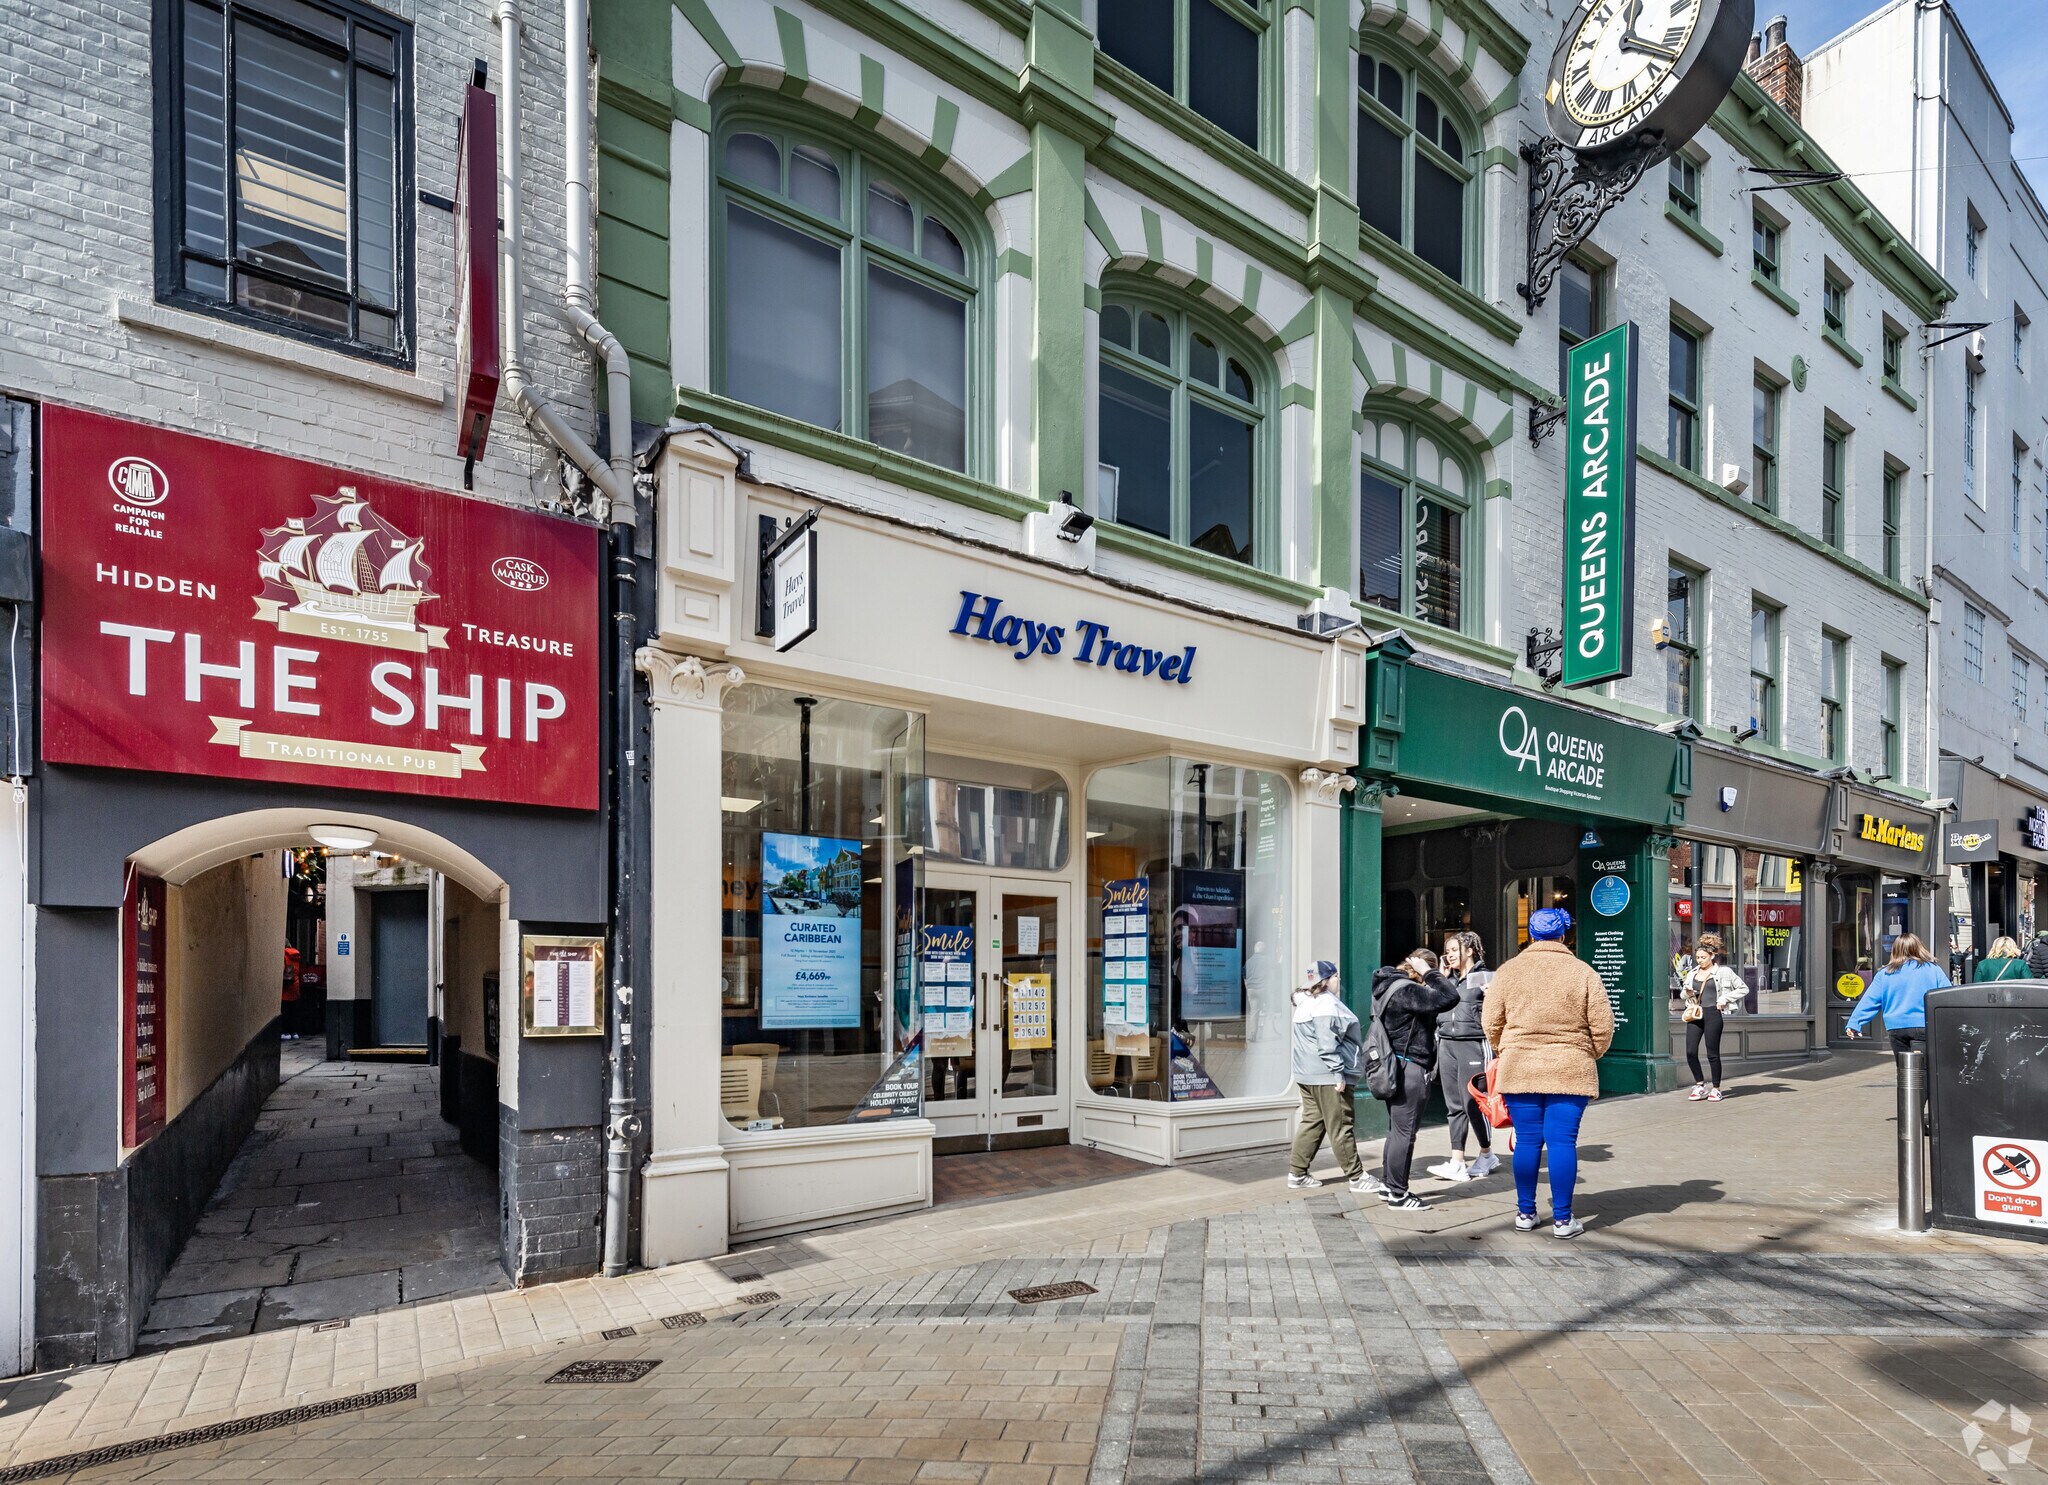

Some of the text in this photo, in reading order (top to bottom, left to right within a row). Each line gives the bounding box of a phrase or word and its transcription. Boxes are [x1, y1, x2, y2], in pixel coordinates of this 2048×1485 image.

[1586, 87, 1668, 146] ARCADE
[117, 466, 155, 499] CAMRA
[113, 503, 165, 521] CAMPAIGN
[1579, 353, 1611, 659] QUEENS ARCADE
[115, 523, 163, 539] REAL ALE
[129, 516, 149, 527] FOR
[497, 567, 545, 585] MARQUE
[505, 560, 535, 573] CASK
[96, 562, 216, 600] HIDDEN
[784, 571, 804, 597] Hays
[782, 586, 806, 620] Travel
[320, 622, 389, 642] EST. 1755
[462, 622, 574, 657] TREASURE
[949, 590, 1197, 685] Hays Travel
[100, 621, 566, 743] THE SHIP
[1499, 706, 1541, 776] QA
[1546, 731, 1604, 764] QUEENS
[267, 741, 436, 770] TRADITIONAL PUB
[1546, 757, 1605, 789] ARCADE
[2036, 806, 2047, 822] THE
[1102, 880, 1149, 910] Smile
[790, 922, 836, 933] CURATED
[1761, 927, 1790, 938] THE 1460
[784, 933, 842, 944] CARIBBEAN
[916, 924, 973, 955] Smile
[1766, 937, 1784, 947] BOOT
[873, 1091, 898, 1099] CELEBRITY
[885, 1082, 919, 1091] BOOK YOUR
[870, 1096, 918, 1107] HOLIDAY TODAY
[1988, 1193, 2038, 1207] Don't drop
[2001, 1203, 2023, 1212] gum
